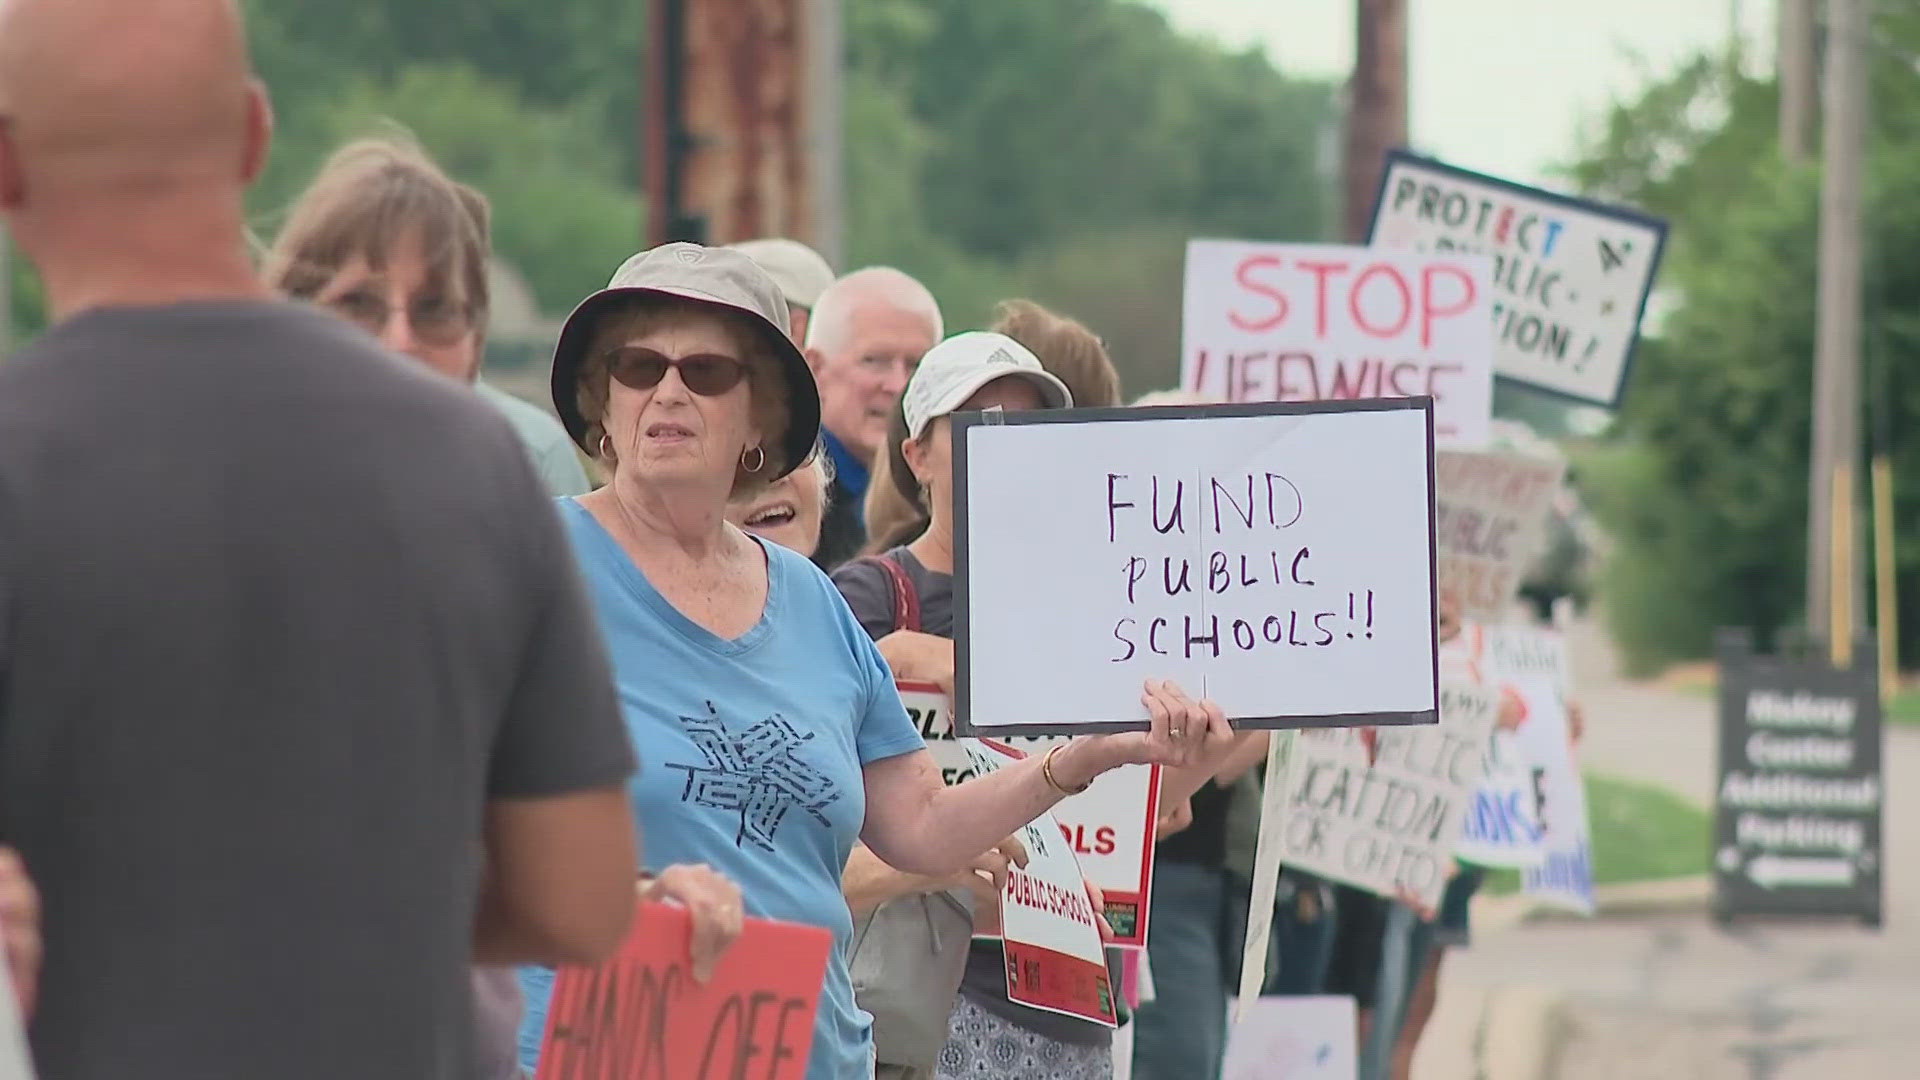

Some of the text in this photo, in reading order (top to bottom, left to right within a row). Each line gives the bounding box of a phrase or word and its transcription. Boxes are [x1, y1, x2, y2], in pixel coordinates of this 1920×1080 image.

[1394, 176, 1566, 258] PROTECT
[1228, 255, 1477, 349] STOP
[1107, 472, 1302, 542] FUND
[1122, 547, 1315, 604] PUBLIC
[1111, 590, 1373, 662] SCHOOLS!!
[1296, 757, 1449, 840] CATION
[1722, 772, 1877, 808] Additional
[1736, 812, 1864, 853] Parking
[1007, 870, 1048, 912] PUBLIC
[1047, 882, 1092, 928] SCHOOLS
[697, 988, 807, 1080] OFF
